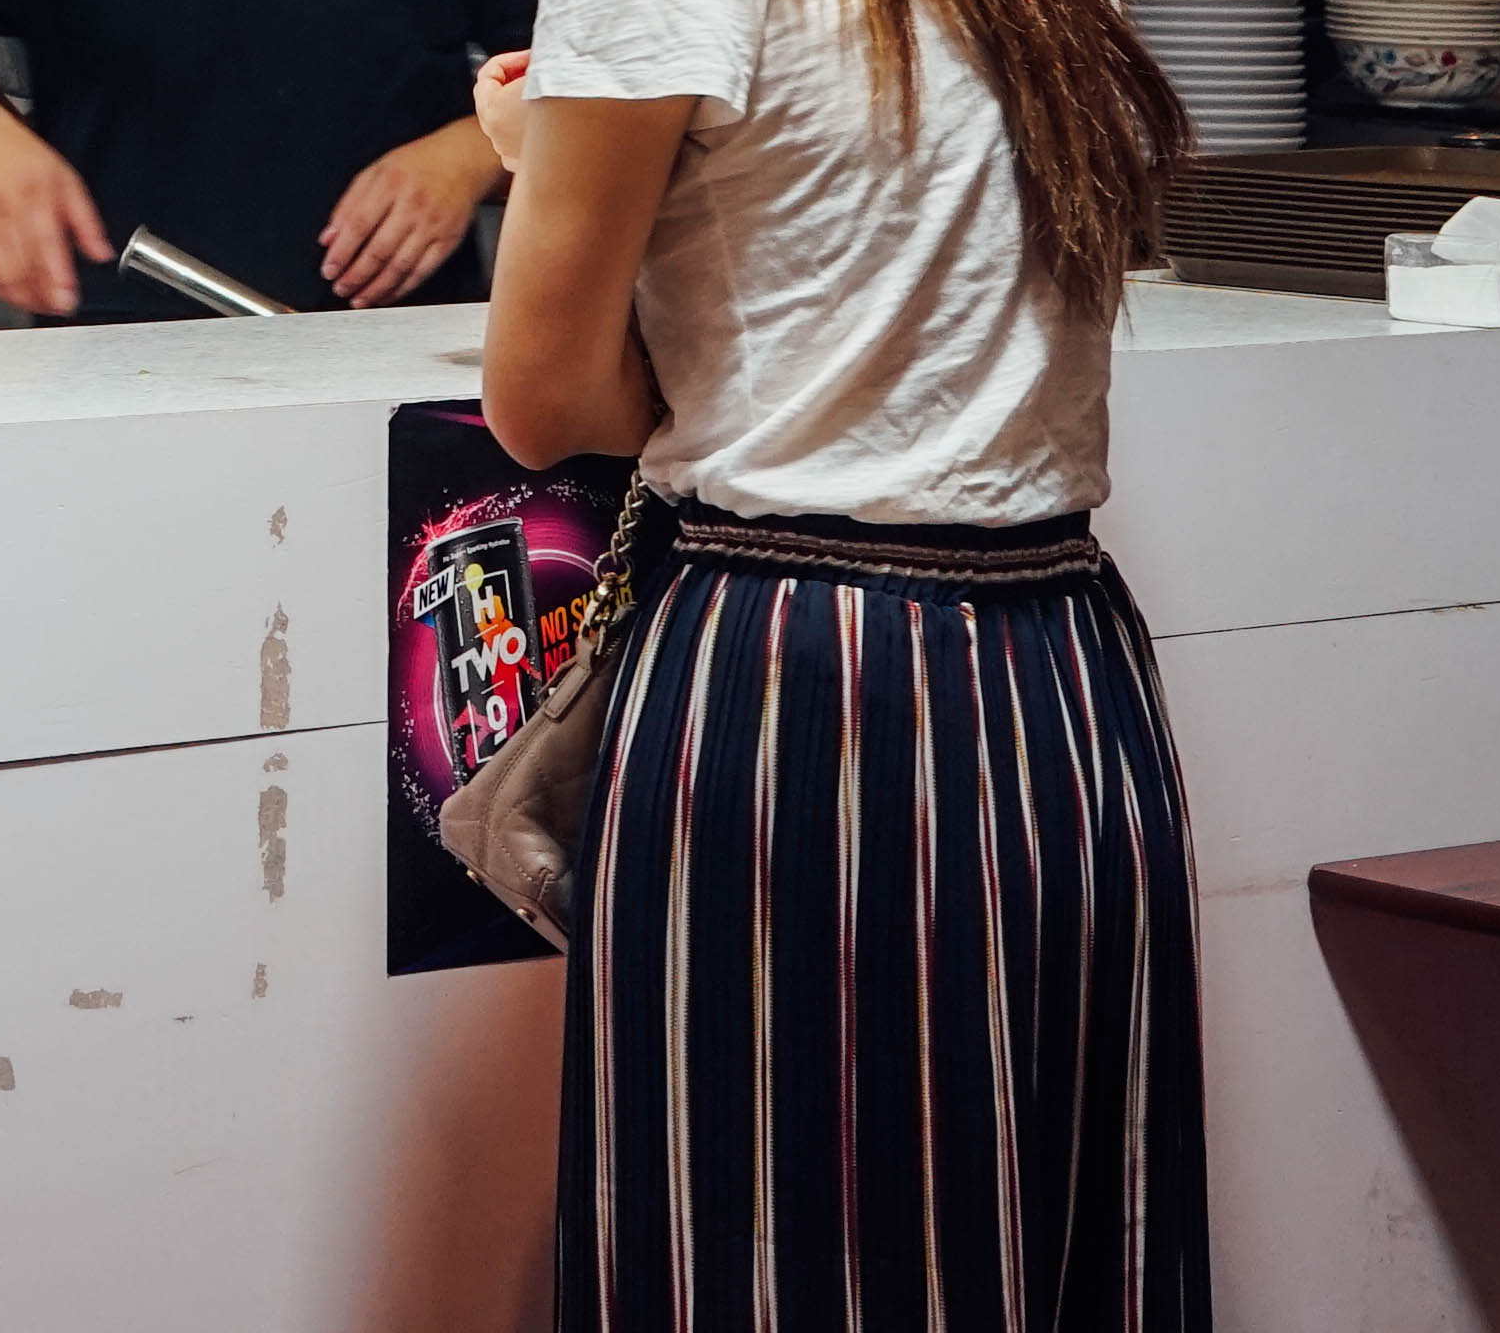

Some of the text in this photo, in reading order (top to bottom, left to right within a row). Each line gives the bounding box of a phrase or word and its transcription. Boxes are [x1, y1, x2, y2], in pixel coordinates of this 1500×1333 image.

[419, 578, 449, 613] NEW
[472, 585, 495, 624] H
[541, 606, 568, 648] NO
[451, 626, 527, 693] TWO
